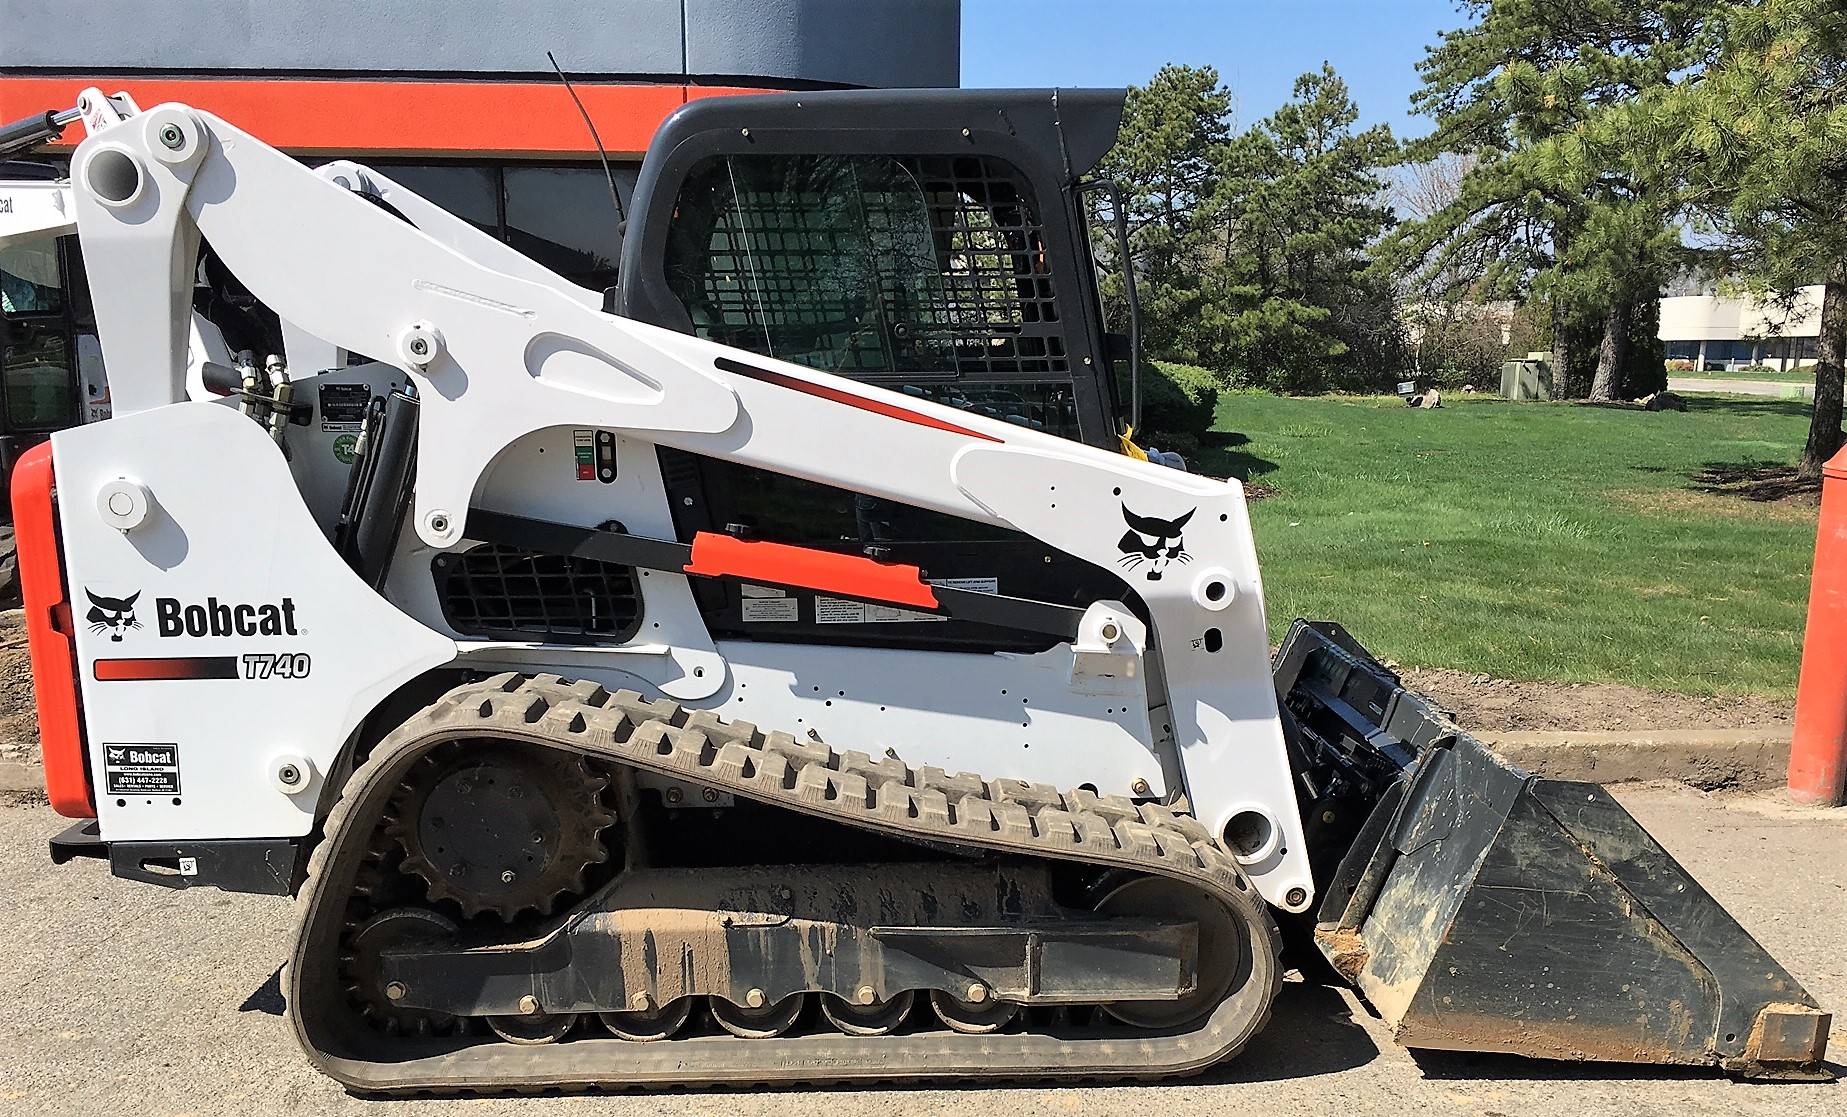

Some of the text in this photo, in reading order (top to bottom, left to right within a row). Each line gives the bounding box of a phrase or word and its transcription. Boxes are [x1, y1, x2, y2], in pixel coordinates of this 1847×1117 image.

[155, 597, 298, 637] Bobcat
[243, 653, 311, 680] T740
[129, 750, 171, 764] Bobcat
